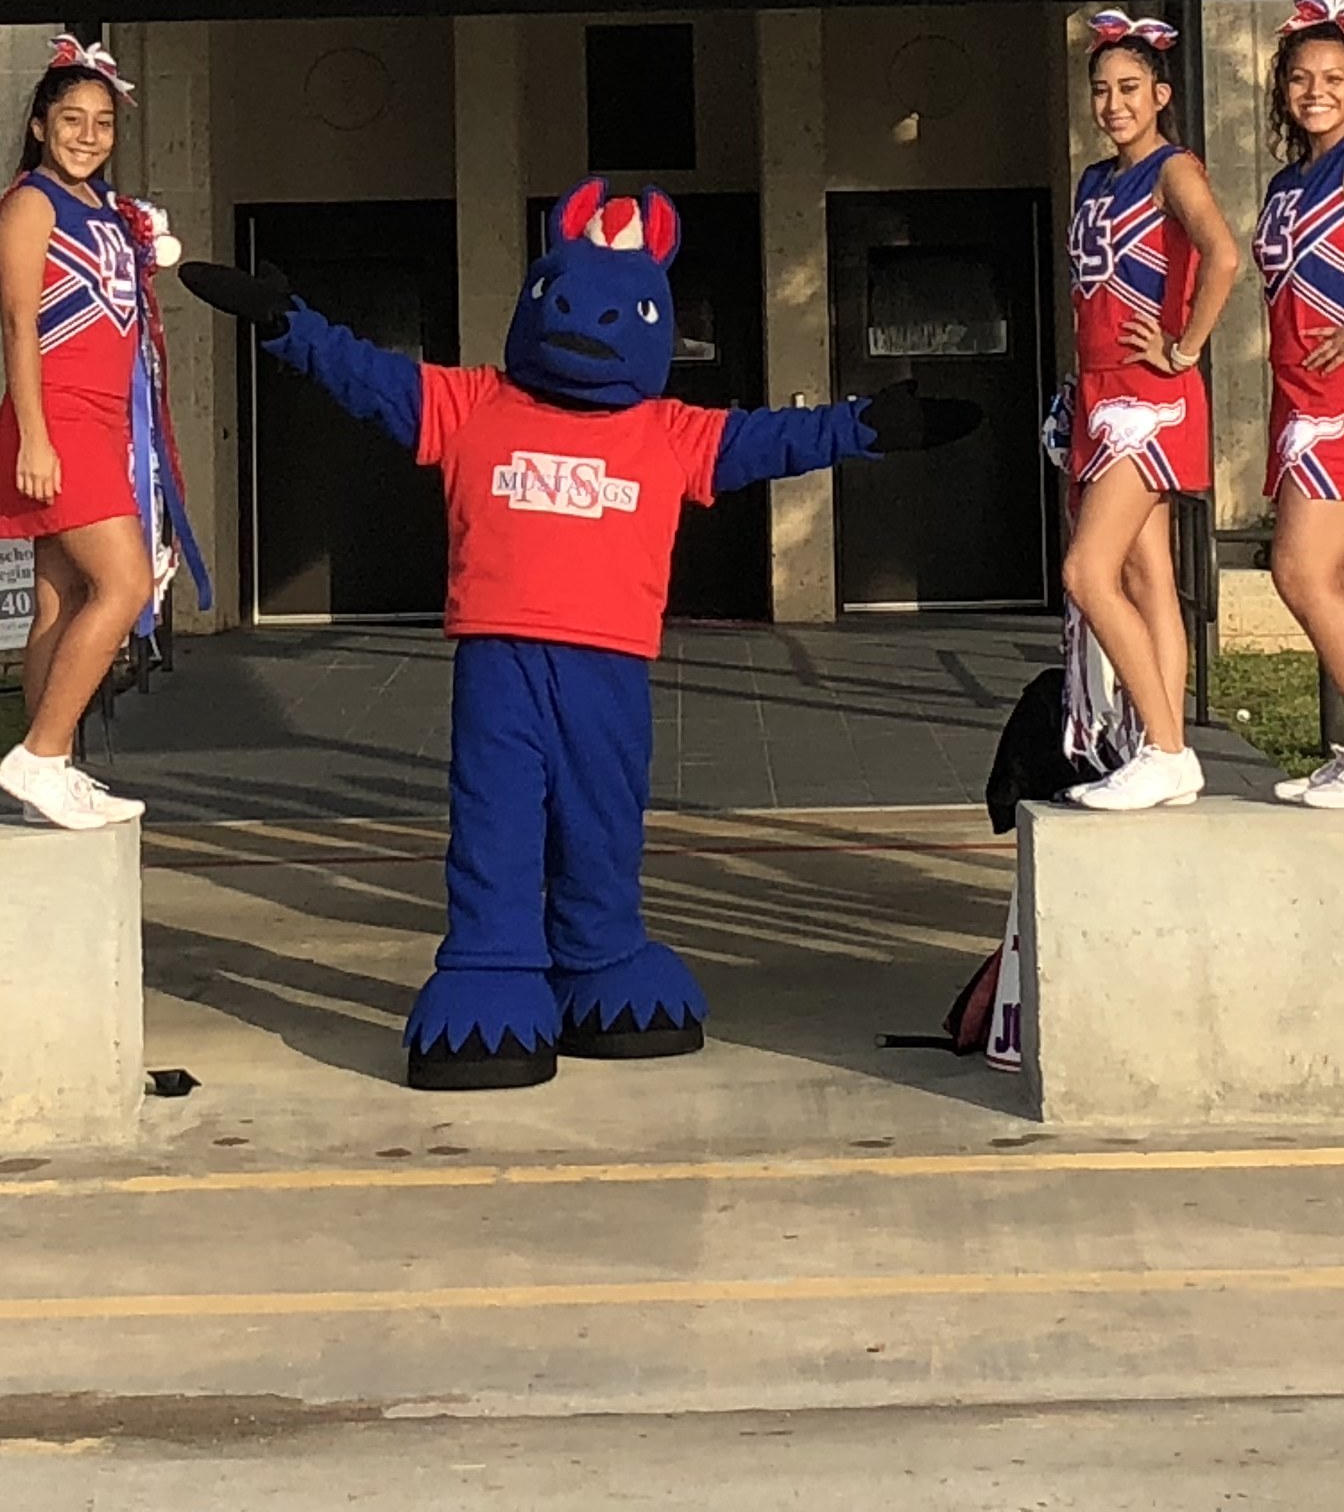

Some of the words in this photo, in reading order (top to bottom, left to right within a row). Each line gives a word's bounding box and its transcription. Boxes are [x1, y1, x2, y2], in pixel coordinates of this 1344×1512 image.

[1068, 195, 1116, 283] NS
[1253, 188, 1304, 271] NS
[515, 455, 601, 510] NS
